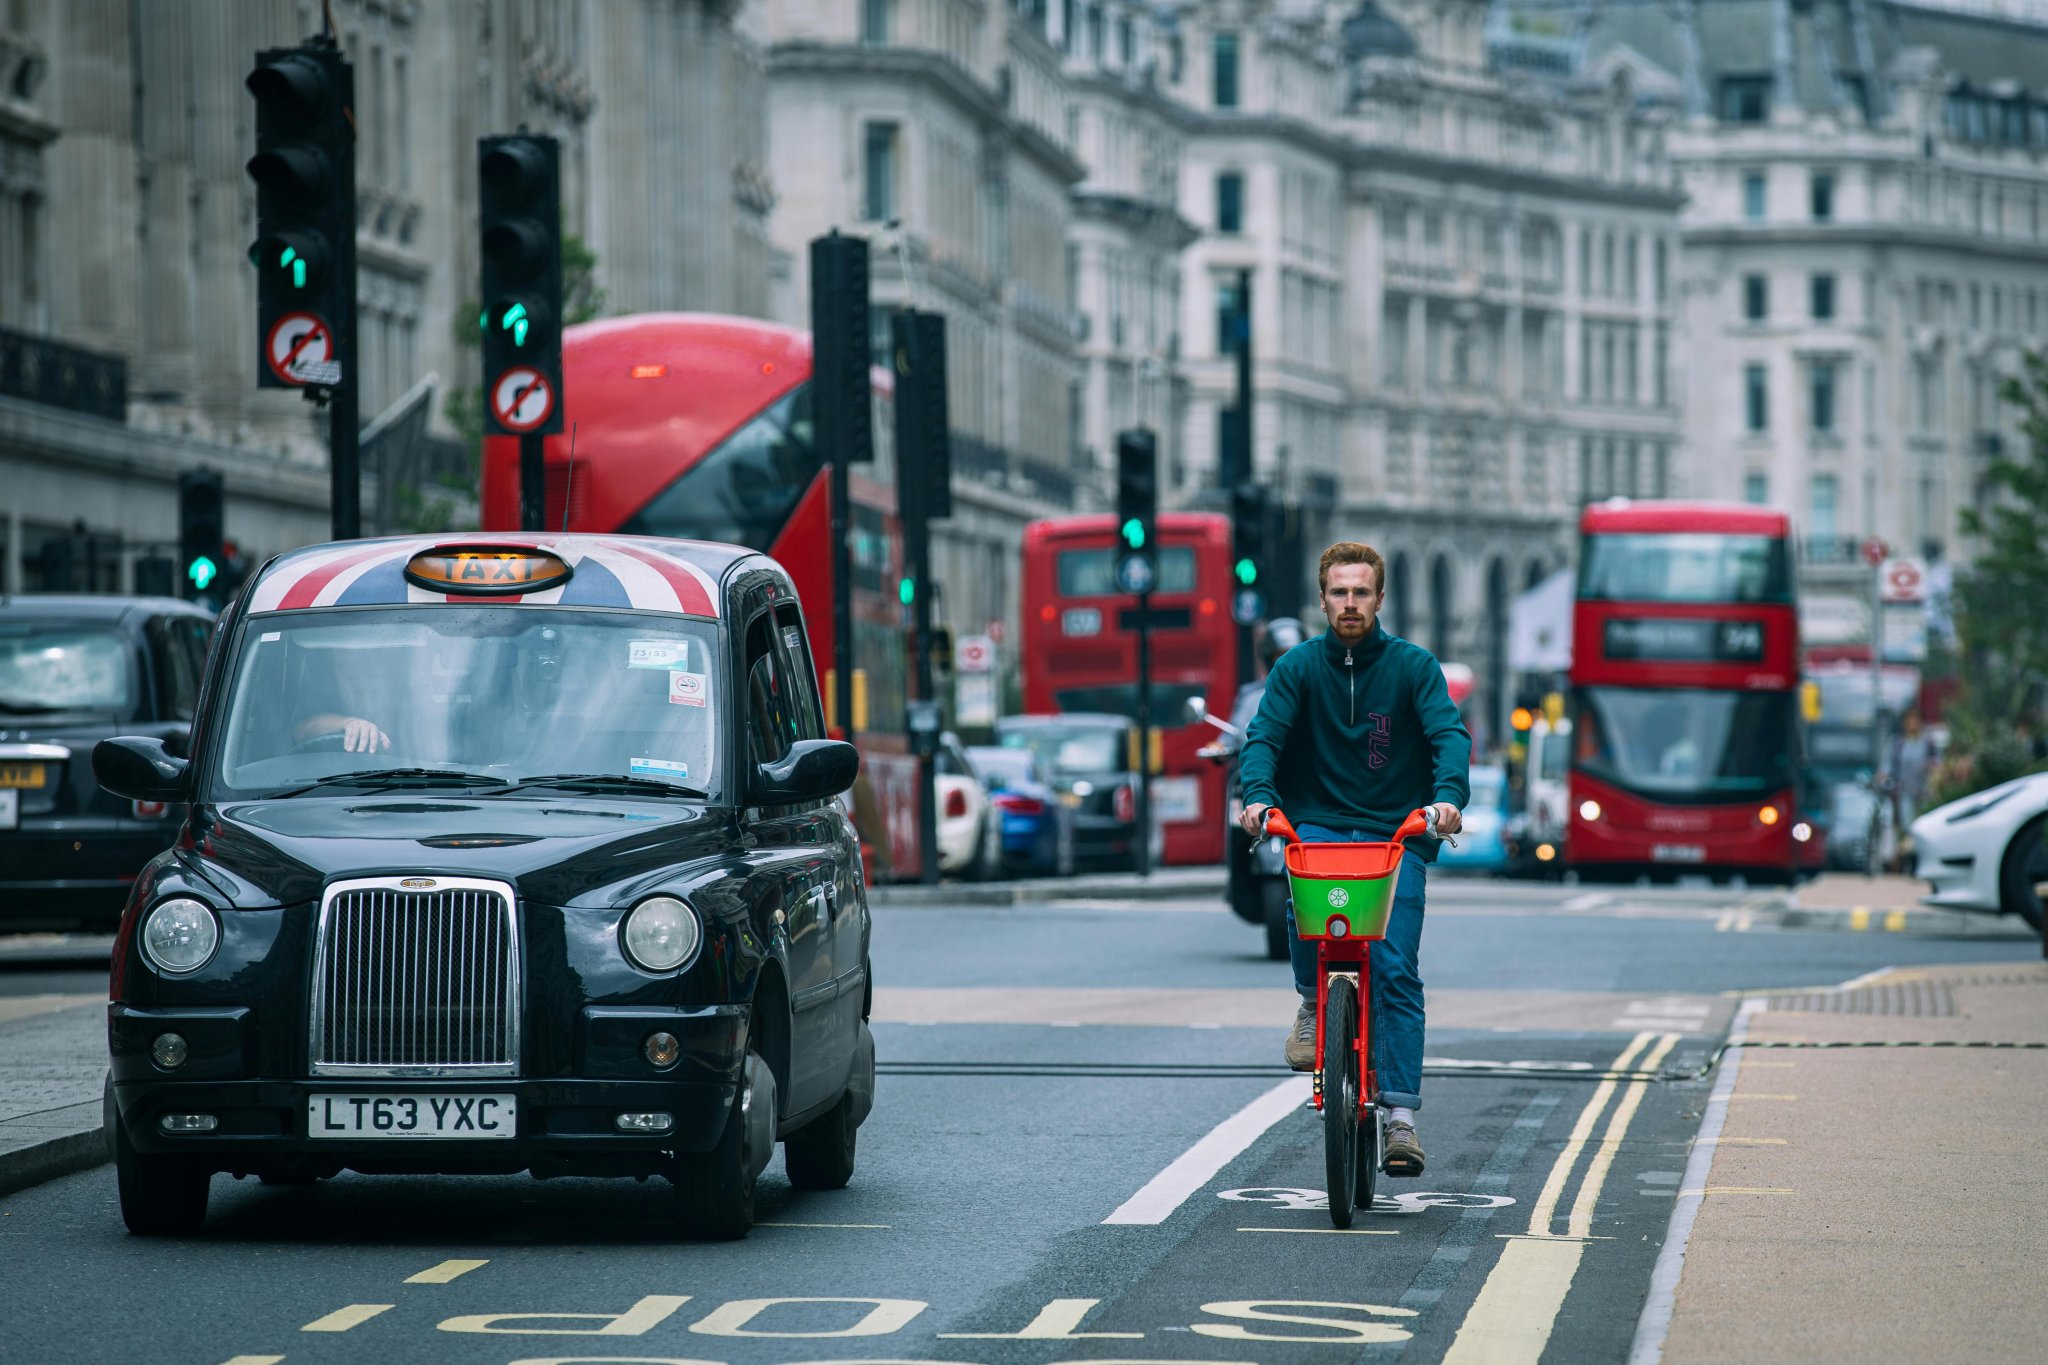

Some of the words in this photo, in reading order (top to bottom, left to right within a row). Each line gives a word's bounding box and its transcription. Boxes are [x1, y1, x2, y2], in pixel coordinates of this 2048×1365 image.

[442, 556, 534, 580] TAXI
[1368, 712, 1391, 769] FILA
[324, 1097, 418, 1130] LT63
[430, 1097, 499, 1130] YXC
[437, 1296, 1419, 1342] STOP
